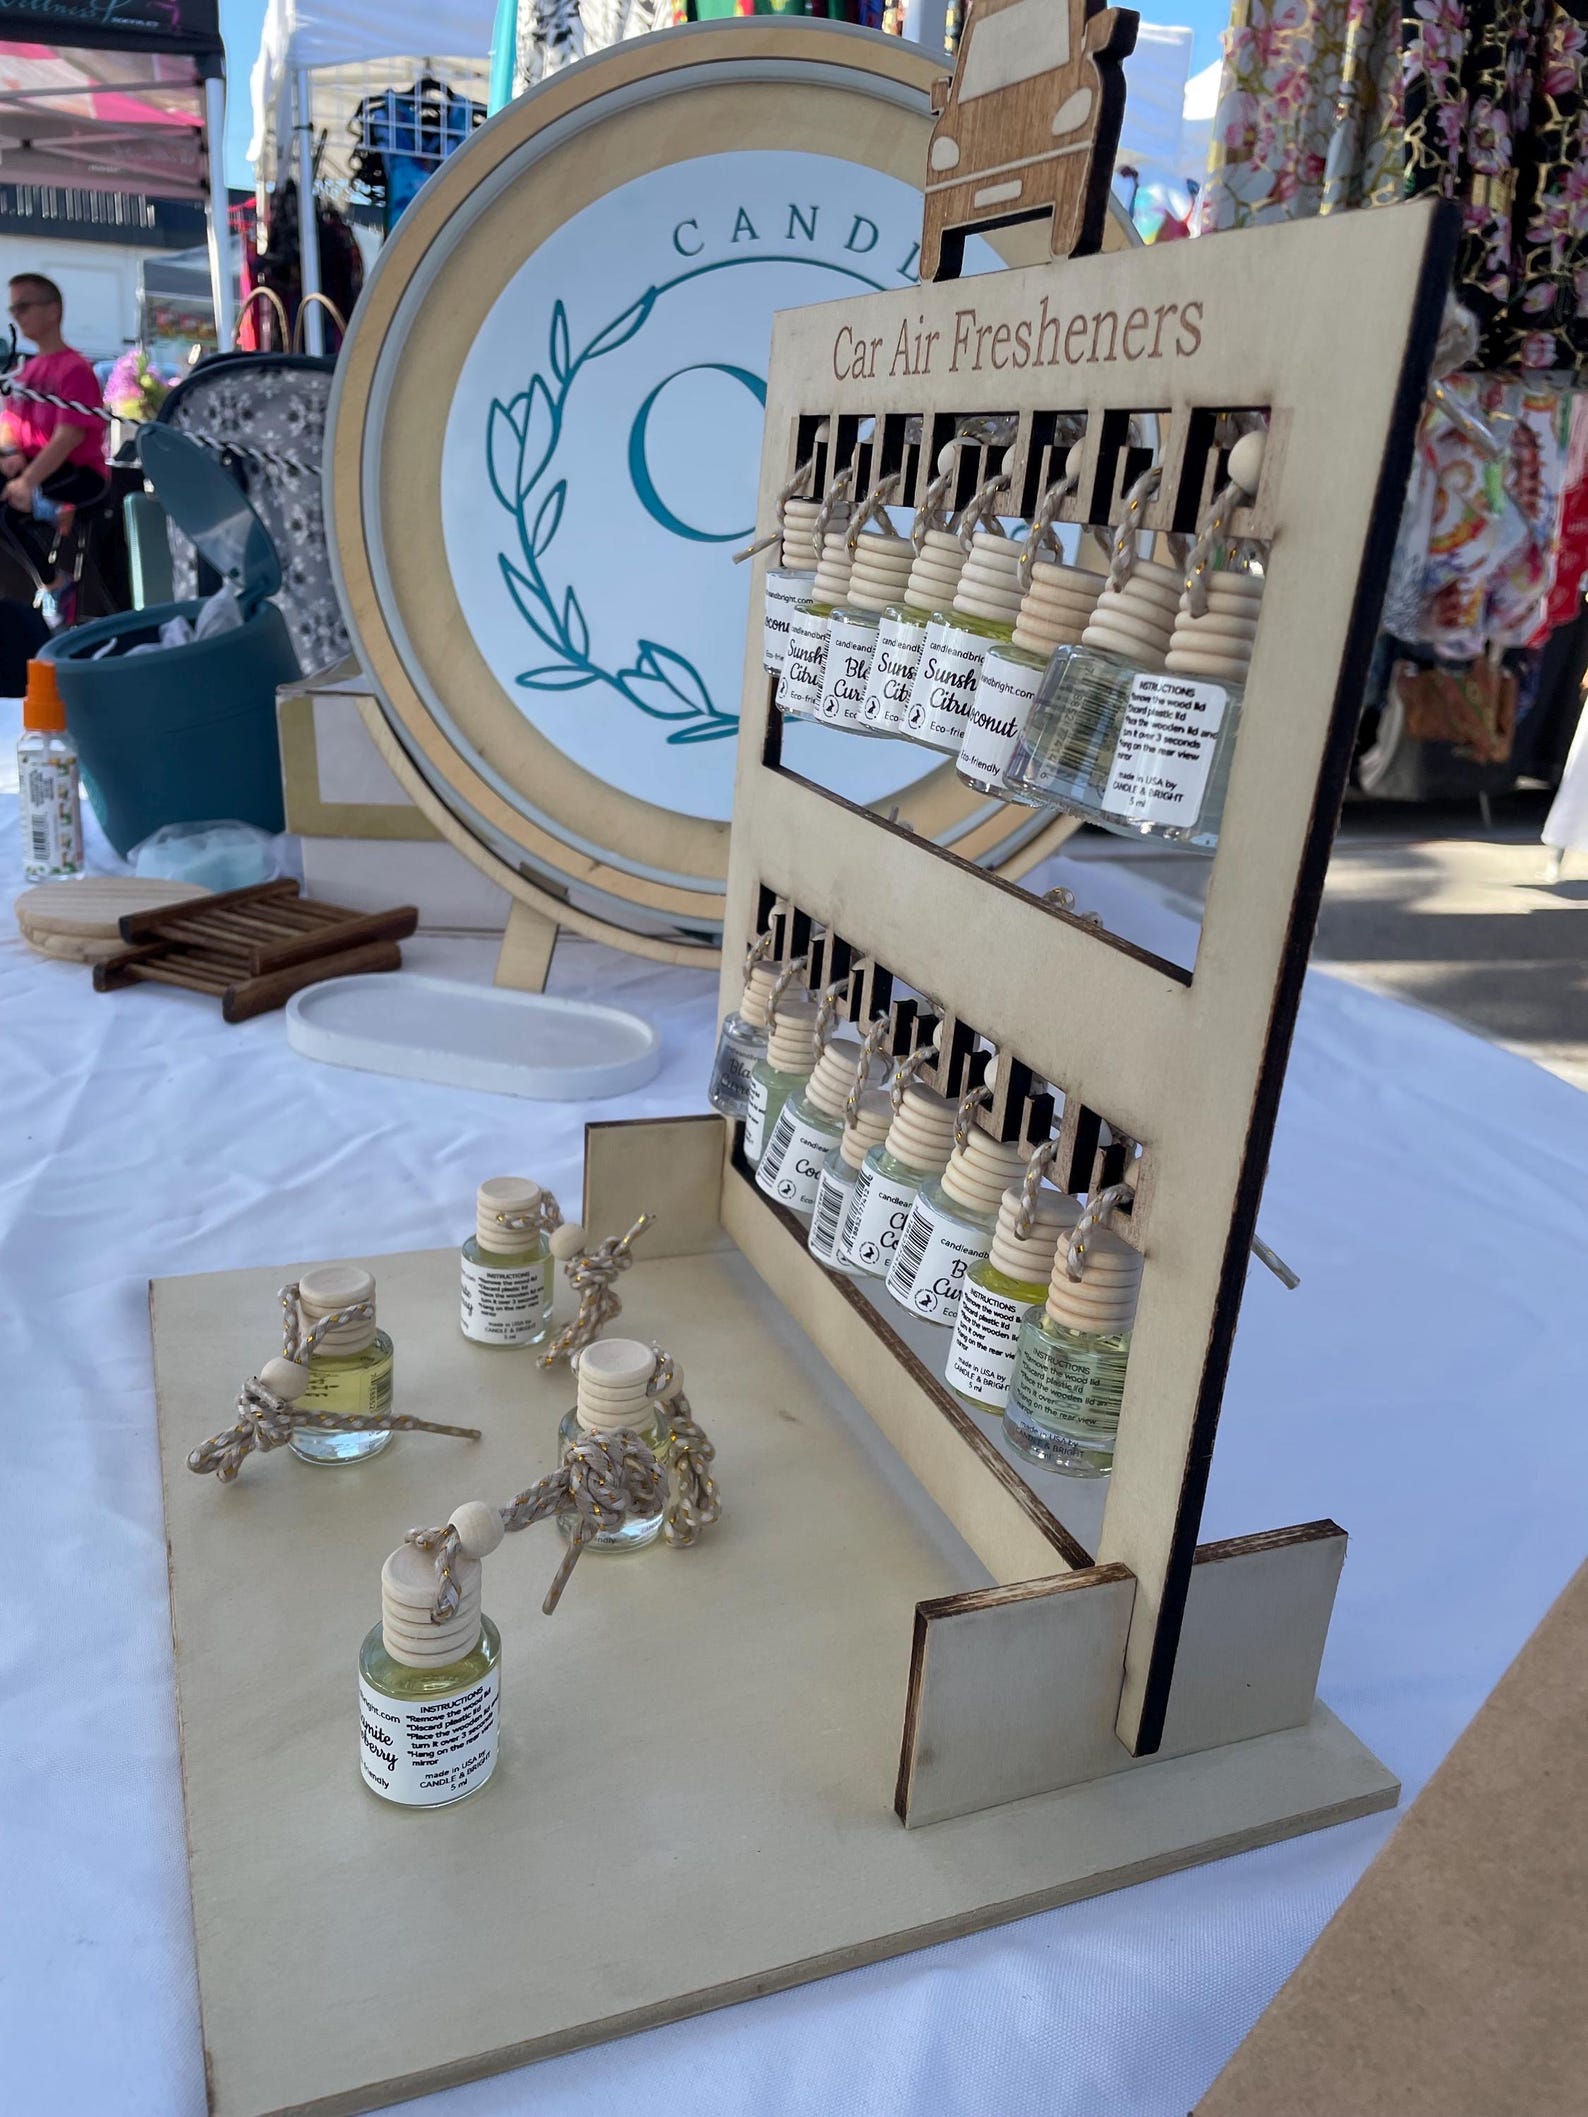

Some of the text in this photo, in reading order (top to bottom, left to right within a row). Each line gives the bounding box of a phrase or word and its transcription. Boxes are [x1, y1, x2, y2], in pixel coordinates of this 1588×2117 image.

[833, 296, 1204, 381] Car Air Fresheners
[971, 1288, 1017, 1313] INSTRUCTIONS
[993, 1310, 1014, 1321] wood
[1033, 1347, 1091, 1375] INSTRUCTIONS
[980, 1368, 995, 1378] USA
[996, 1373, 1006, 1383] by
[1050, 1367, 1063, 1377] the
[1064, 1373, 1088, 1384] wood
[1090, 1378, 1100, 1387] lid
[968, 1381, 973, 1389] 5
[1037, 1381, 1049, 1392] the
[1050, 1388, 1083, 1403] wooden
[1046, 1376, 1072, 1391] plastic
[1072, 1384, 1084, 1394] lid
[1038, 1394, 1055, 1405] over
[1033, 1401, 1043, 1410] on
[1044, 1406, 1058, 1416] the
[420, 1685, 484, 1713] INSTRUCTIONS
[446, 1709, 461, 1718] the
[462, 1694, 483, 1711] wood
[435, 1730, 450, 1738] the
[452, 1714, 482, 1733] wooden
[445, 1712, 471, 1729] plastic
[440, 1735, 460, 1746] over
[450, 1742, 464, 1752] the
[425, 1769, 449, 1779] made
[461, 1756, 477, 1769] USA
[420, 1774, 456, 1788] CANDLE
[459, 1771, 465, 1779] &
[450, 1778, 468, 1791] 5 ml
